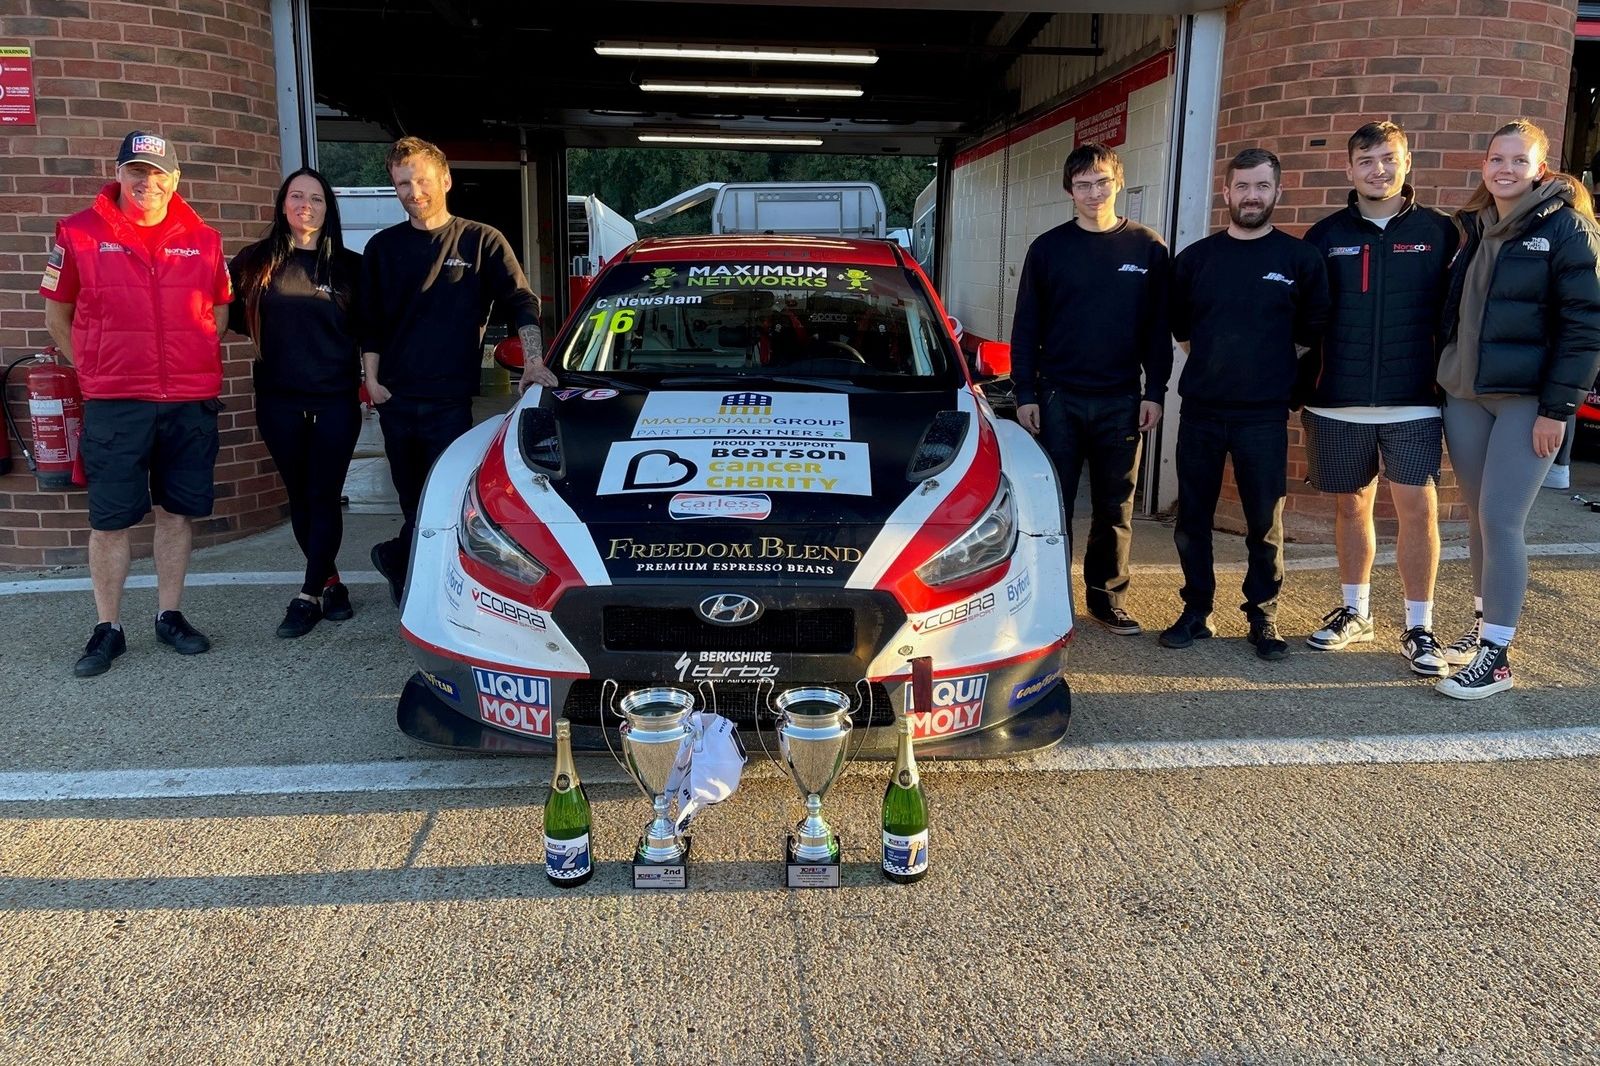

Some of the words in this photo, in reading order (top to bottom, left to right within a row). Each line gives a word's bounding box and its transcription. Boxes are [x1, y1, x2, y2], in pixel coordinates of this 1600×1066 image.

[135, 143, 163, 153] MOLY
[136, 137, 163, 146] LIQUI
[688, 265, 828, 278] MAXIMUM
[687, 275, 828, 288] NETWORKS
[596, 298, 612, 309] C.
[616, 294, 702, 308] Newsham
[589, 309, 635, 334] 16
[637, 428, 687, 437] PART
[693, 428, 718, 436] OF
[727, 428, 824, 437] PARTNERS
[833, 430, 844, 438] &
[680, 498, 760, 508] carless
[605, 538, 753, 560] FREEDOM
[758, 536, 864, 563] BLEND
[636, 562, 708, 572] PREMIUM
[713, 562, 783, 573] ESPRESSO
[787, 563, 835, 575] BEANS
[966, 608, 996, 622] SPORT
[518, 620, 547, 633] SPORT
[699, 651, 772, 663] BERKSHIRE
[691, 664, 780, 677] turbo
[476, 671, 546, 705] LIQUI
[481, 696, 549, 733] MOLY
[912, 703, 981, 737] MOLY
